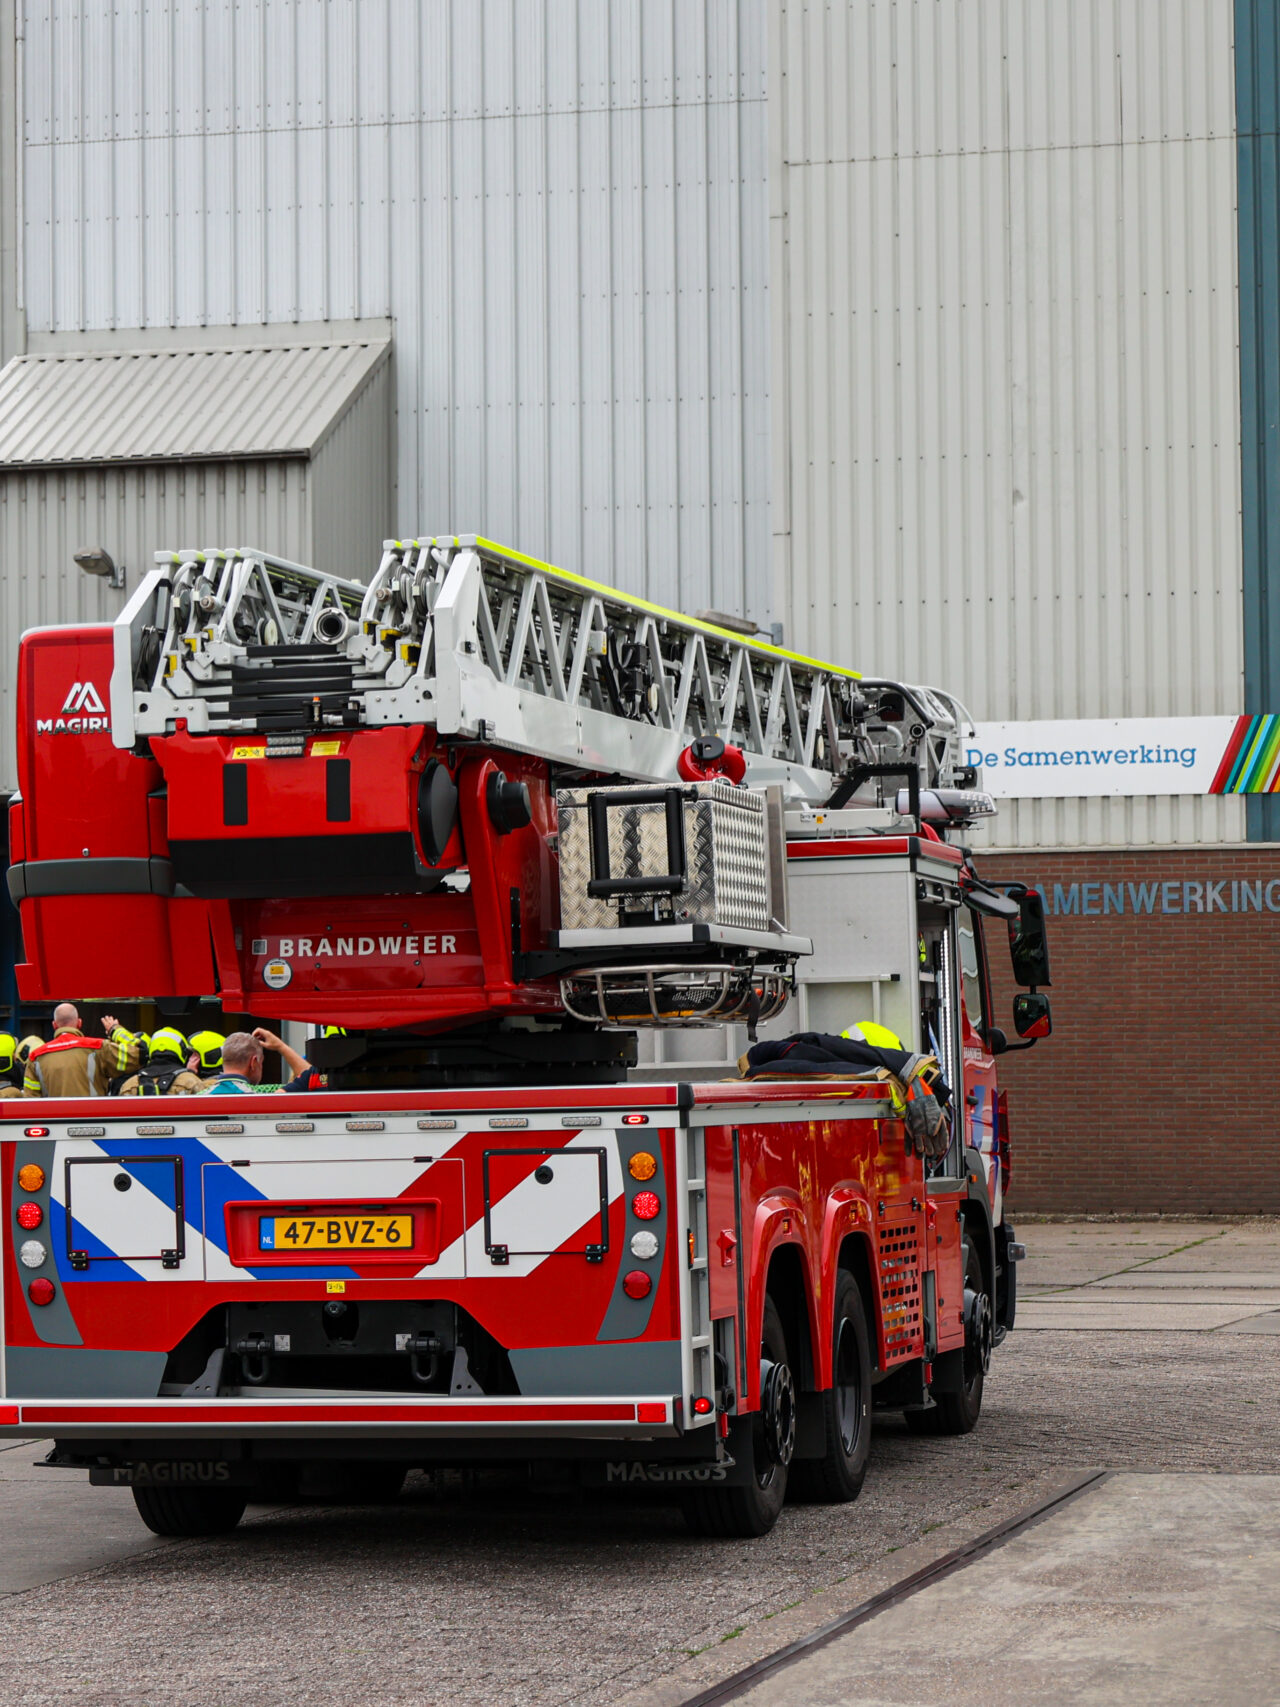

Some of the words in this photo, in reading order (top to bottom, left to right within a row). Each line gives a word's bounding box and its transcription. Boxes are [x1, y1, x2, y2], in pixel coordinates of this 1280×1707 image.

[965, 748, 999, 768] De
[1004, 744, 1197, 769] Samenwerking
[279, 934, 457, 958] BRANDWEER
[262, 1236, 273, 1244] NL
[284, 1219, 401, 1244] 47-BVZ-6
